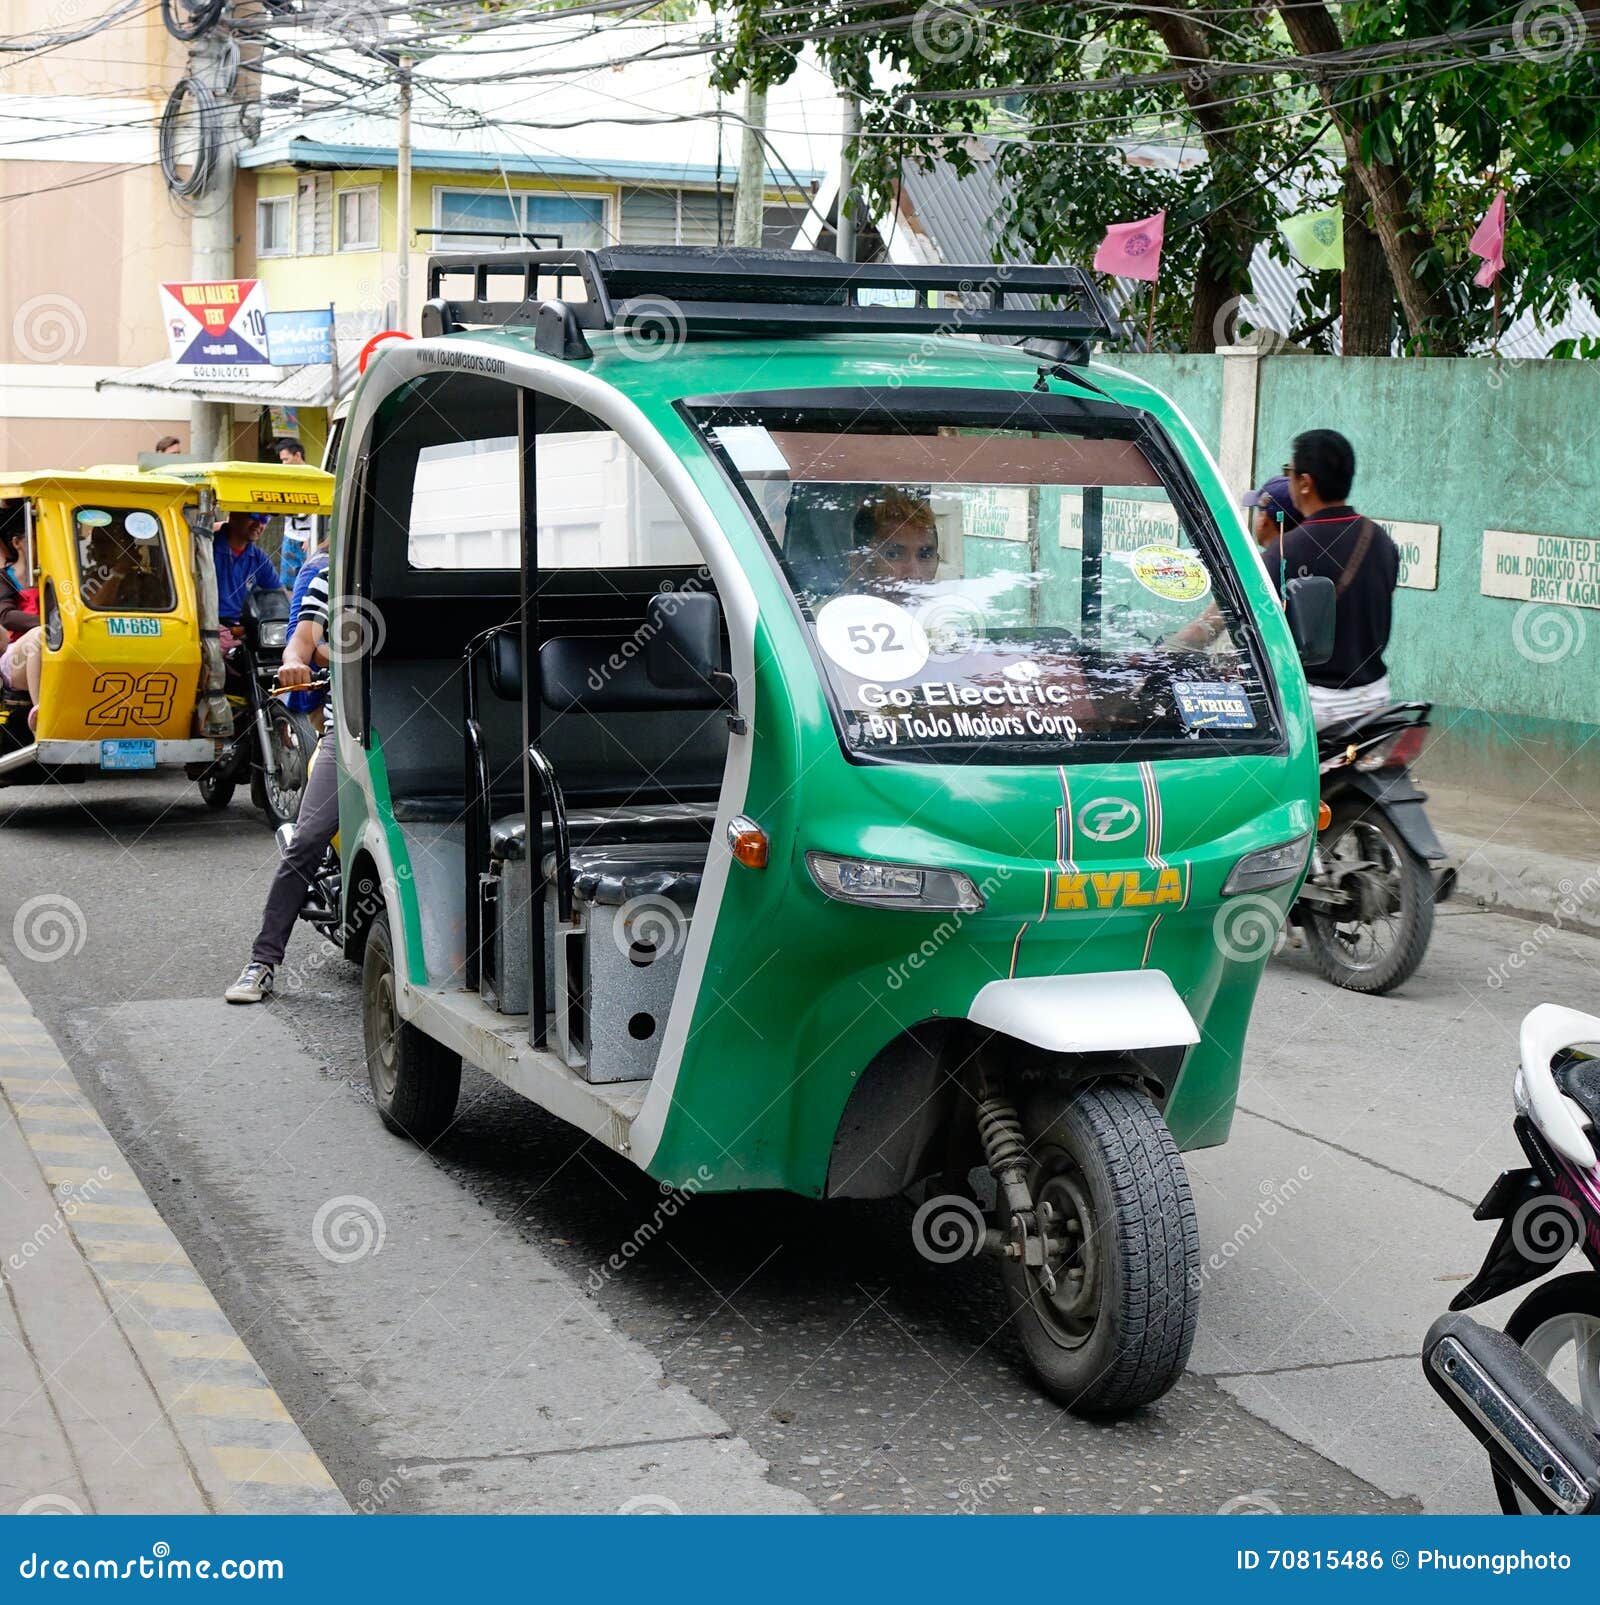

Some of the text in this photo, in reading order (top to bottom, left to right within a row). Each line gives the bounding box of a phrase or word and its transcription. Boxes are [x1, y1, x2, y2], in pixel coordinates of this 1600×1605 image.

[416, 347, 506, 375] www.ToJoMotors.com
[251, 490, 319, 505] FOR HIRE
[1537, 537, 1590, 562] DONATED
[1496, 554, 1523, 576] HON.
[1525, 556, 1575, 580] DIONISIO
[1530, 578, 1561, 601] BRGY
[846, 622, 905, 655] 52
[85, 671, 178, 727] 23
[857, 680, 1070, 708] Go Electric
[1181, 699, 1247, 713] E-TRIKE
[868, 709, 1083, 745] By ToJo Motors Corp.
[1054, 867, 1183, 910] KYLA
